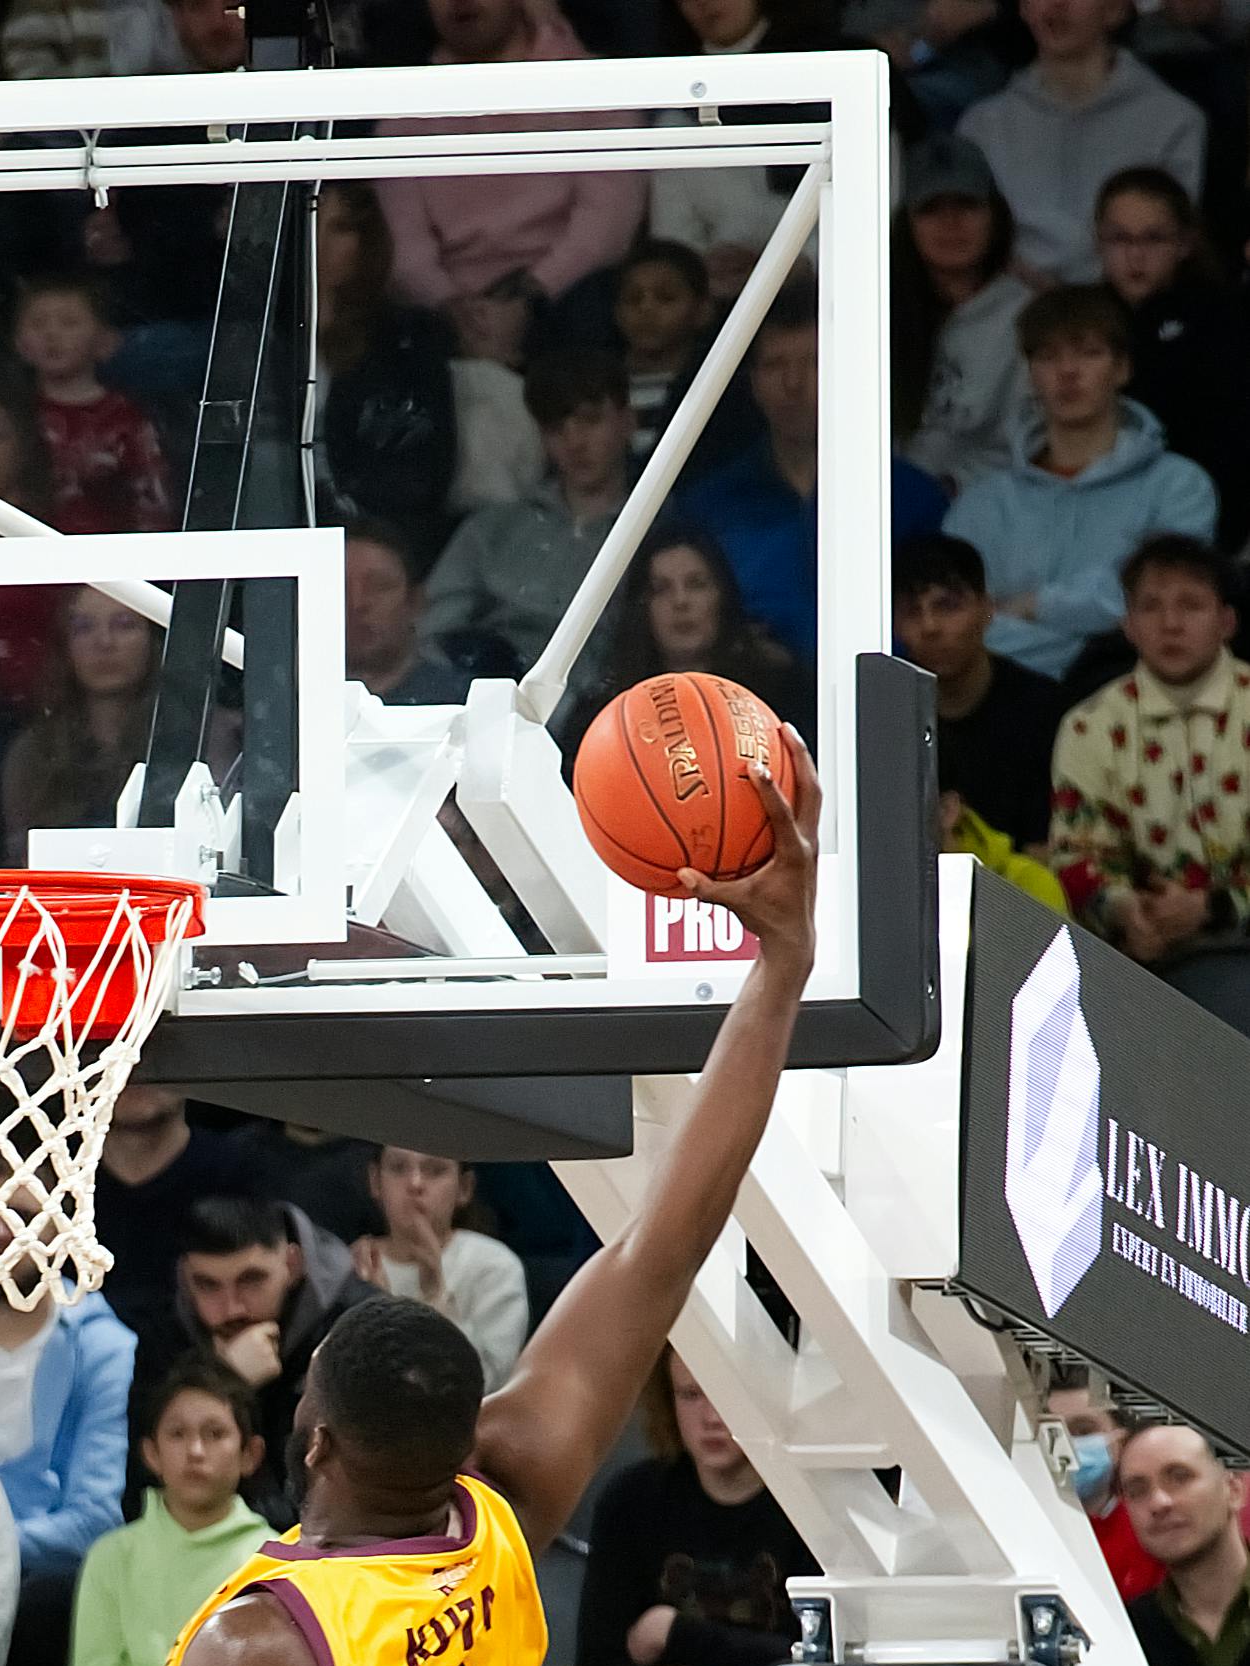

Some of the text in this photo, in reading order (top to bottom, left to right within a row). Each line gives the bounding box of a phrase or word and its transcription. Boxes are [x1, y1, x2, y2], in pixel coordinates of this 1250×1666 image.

[654, 894, 745, 953] PRO
[1106, 1118, 1166, 1229] LEX
[1112, 1222, 1249, 1335] EXPERT EN IMMOBILIER
